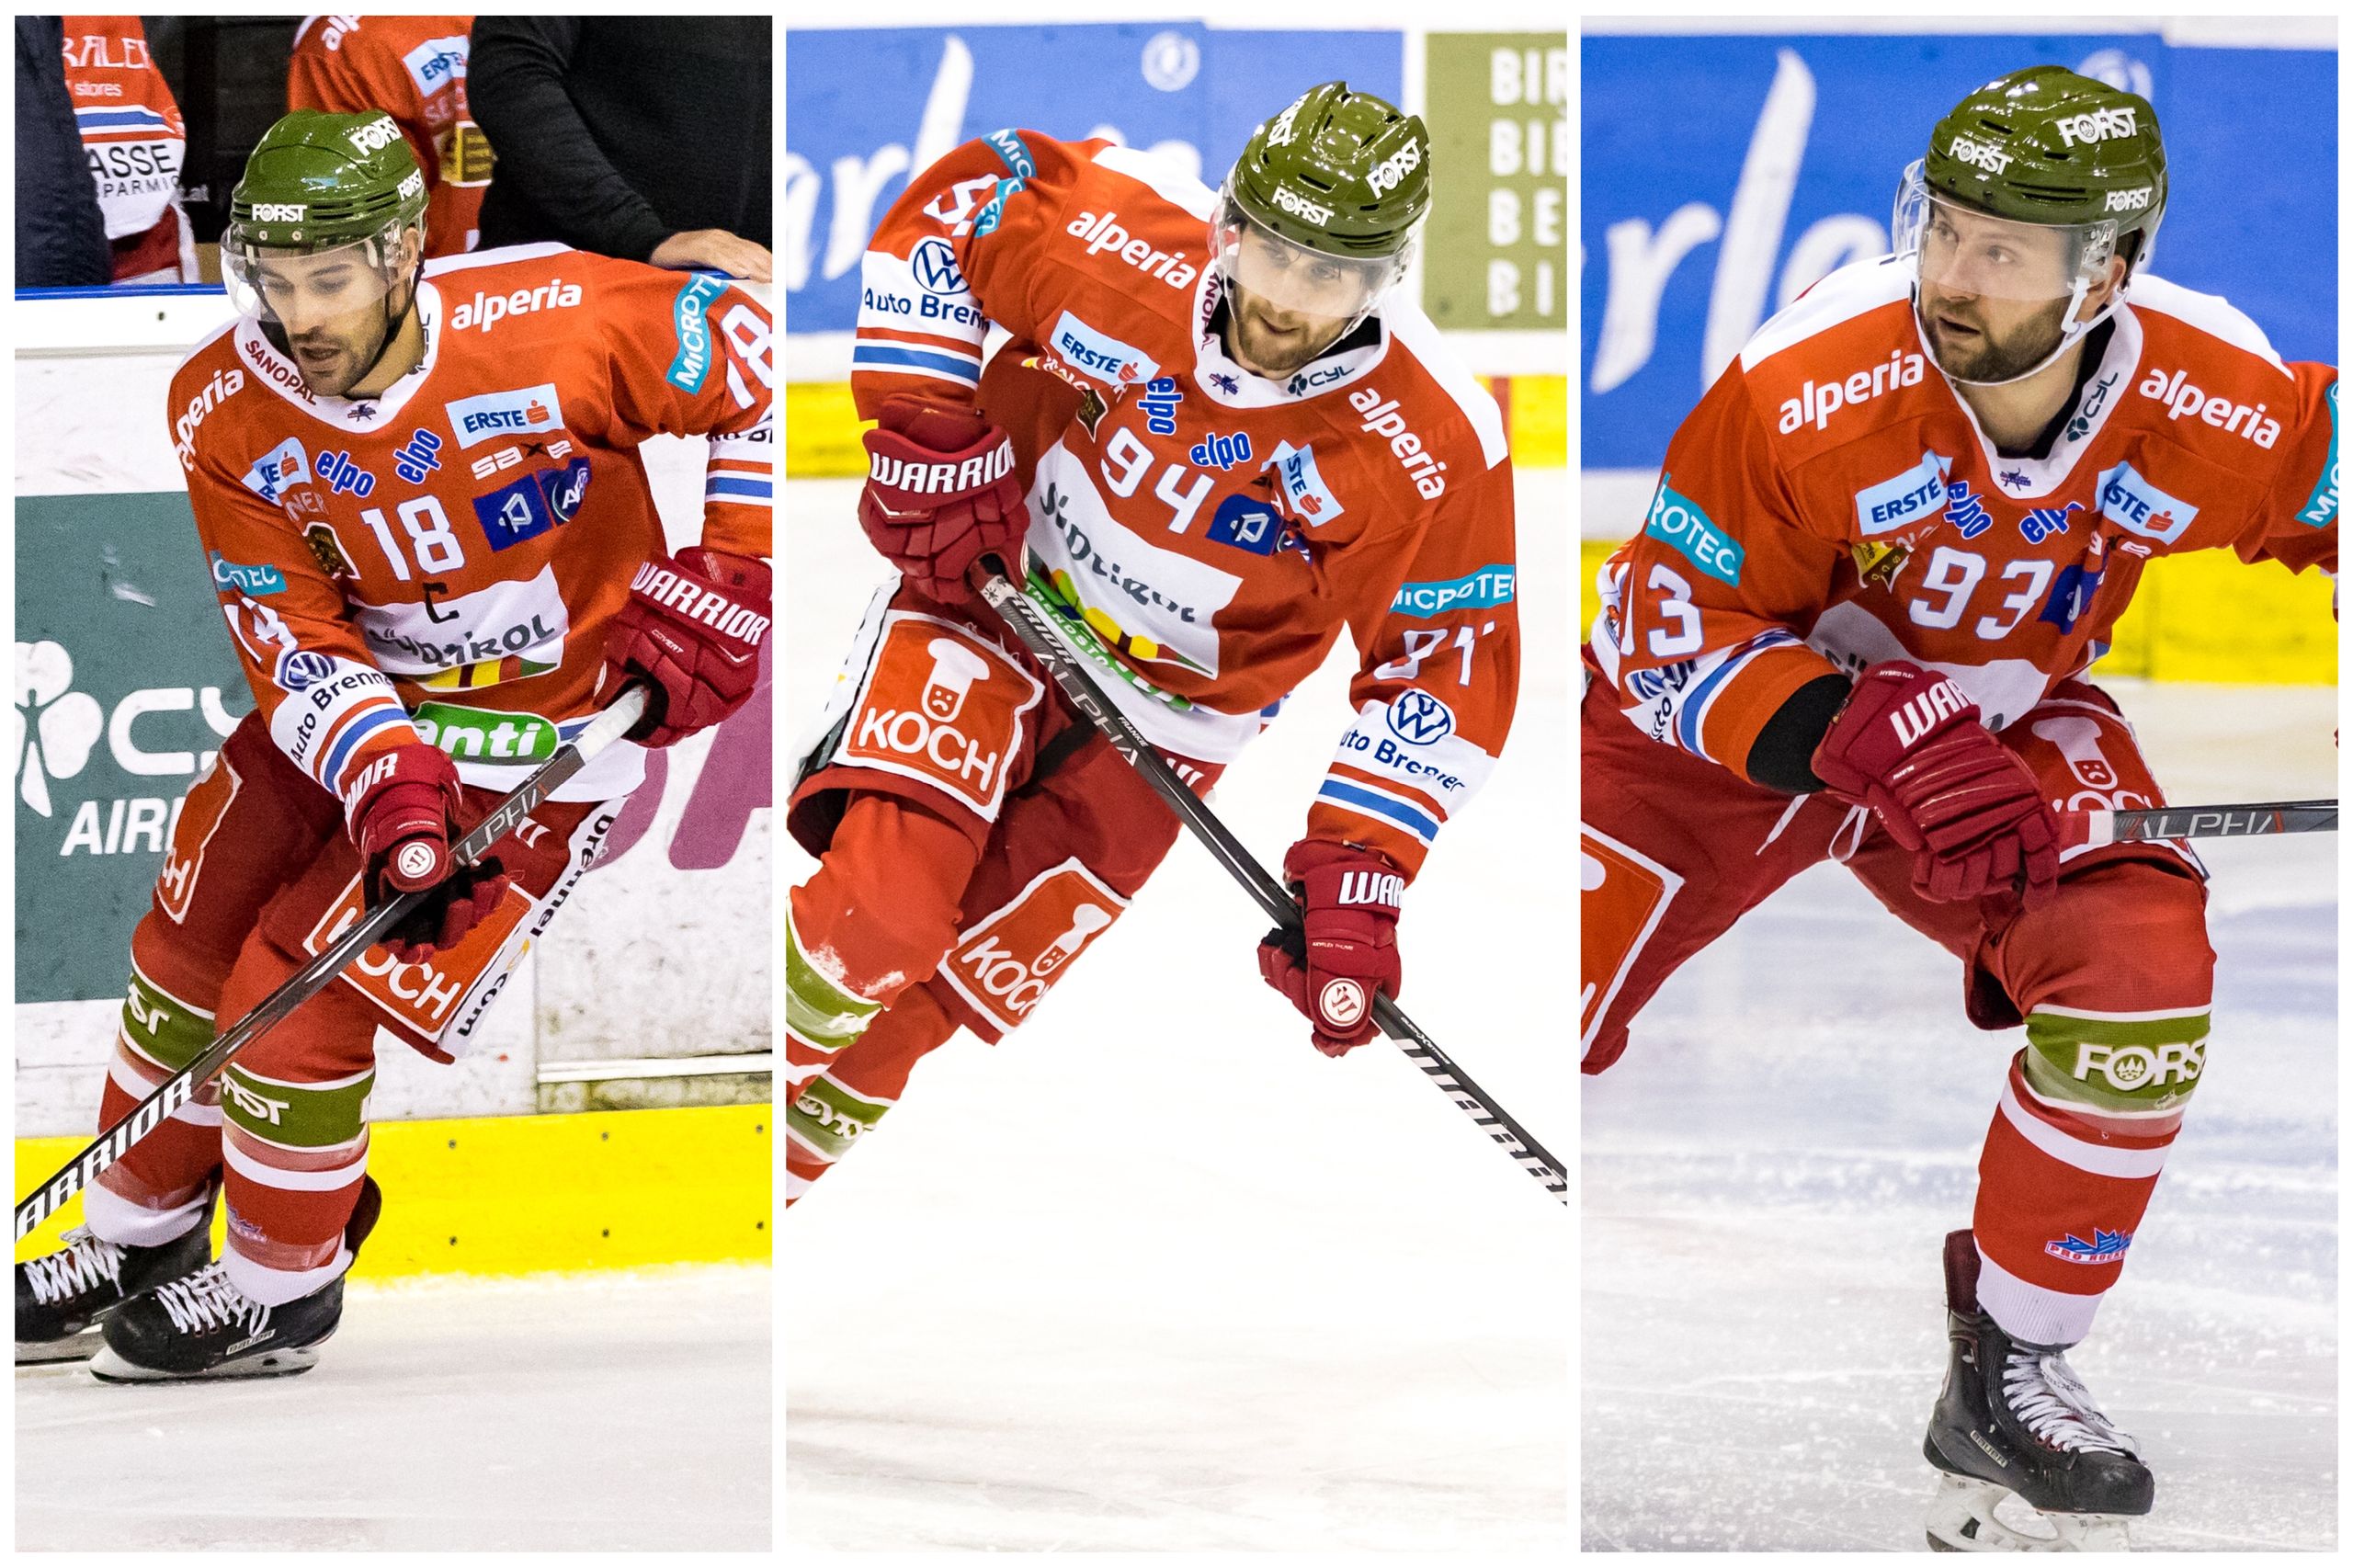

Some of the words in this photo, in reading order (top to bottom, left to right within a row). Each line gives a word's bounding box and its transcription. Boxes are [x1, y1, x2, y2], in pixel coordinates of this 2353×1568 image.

[2056, 106, 2137, 148] FORST
[1365, 135, 1421, 199] FORST
[1949, 136, 2015, 176] FORST
[251, 203, 309, 222] FORST
[1271, 186, 1336, 228] FORST
[2104, 187, 2154, 212] FORST
[1066, 210, 1198, 290] alperia
[450, 278, 584, 333] alperia
[863, 286, 912, 316] Auto
[244, 338, 317, 406] SANOPAL
[1061, 331, 1122, 374] ERSTE
[1308, 365, 1356, 387] CYL
[1138, 376, 1185, 436] elpo
[1779, 348, 1925, 436] alperia
[2138, 367, 2281, 450] alperia
[463, 409, 527, 434] ERSTE
[1347, 386, 1448, 501] alperia
[315, 449, 376, 497] elpo
[393, 426, 442, 484] elpo
[1189, 431, 1253, 472] elpo
[1100, 426, 1216, 536] 94
[1870, 476, 1942, 525] ERSTE
[1943, 480, 1993, 540] elpo
[359, 494, 466, 582] 18
[422, 581, 460, 624] C
[630, 561, 771, 646] WARRIOR
[1908, 545, 2056, 642] 93
[290, 711, 317, 768] Auto
[857, 706, 998, 792] KOCH
[1117, 715, 1149, 748] FRANKIE
[2129, 810, 2284, 840] ALPHA
[2050, 1244, 2082, 1260] PRO
